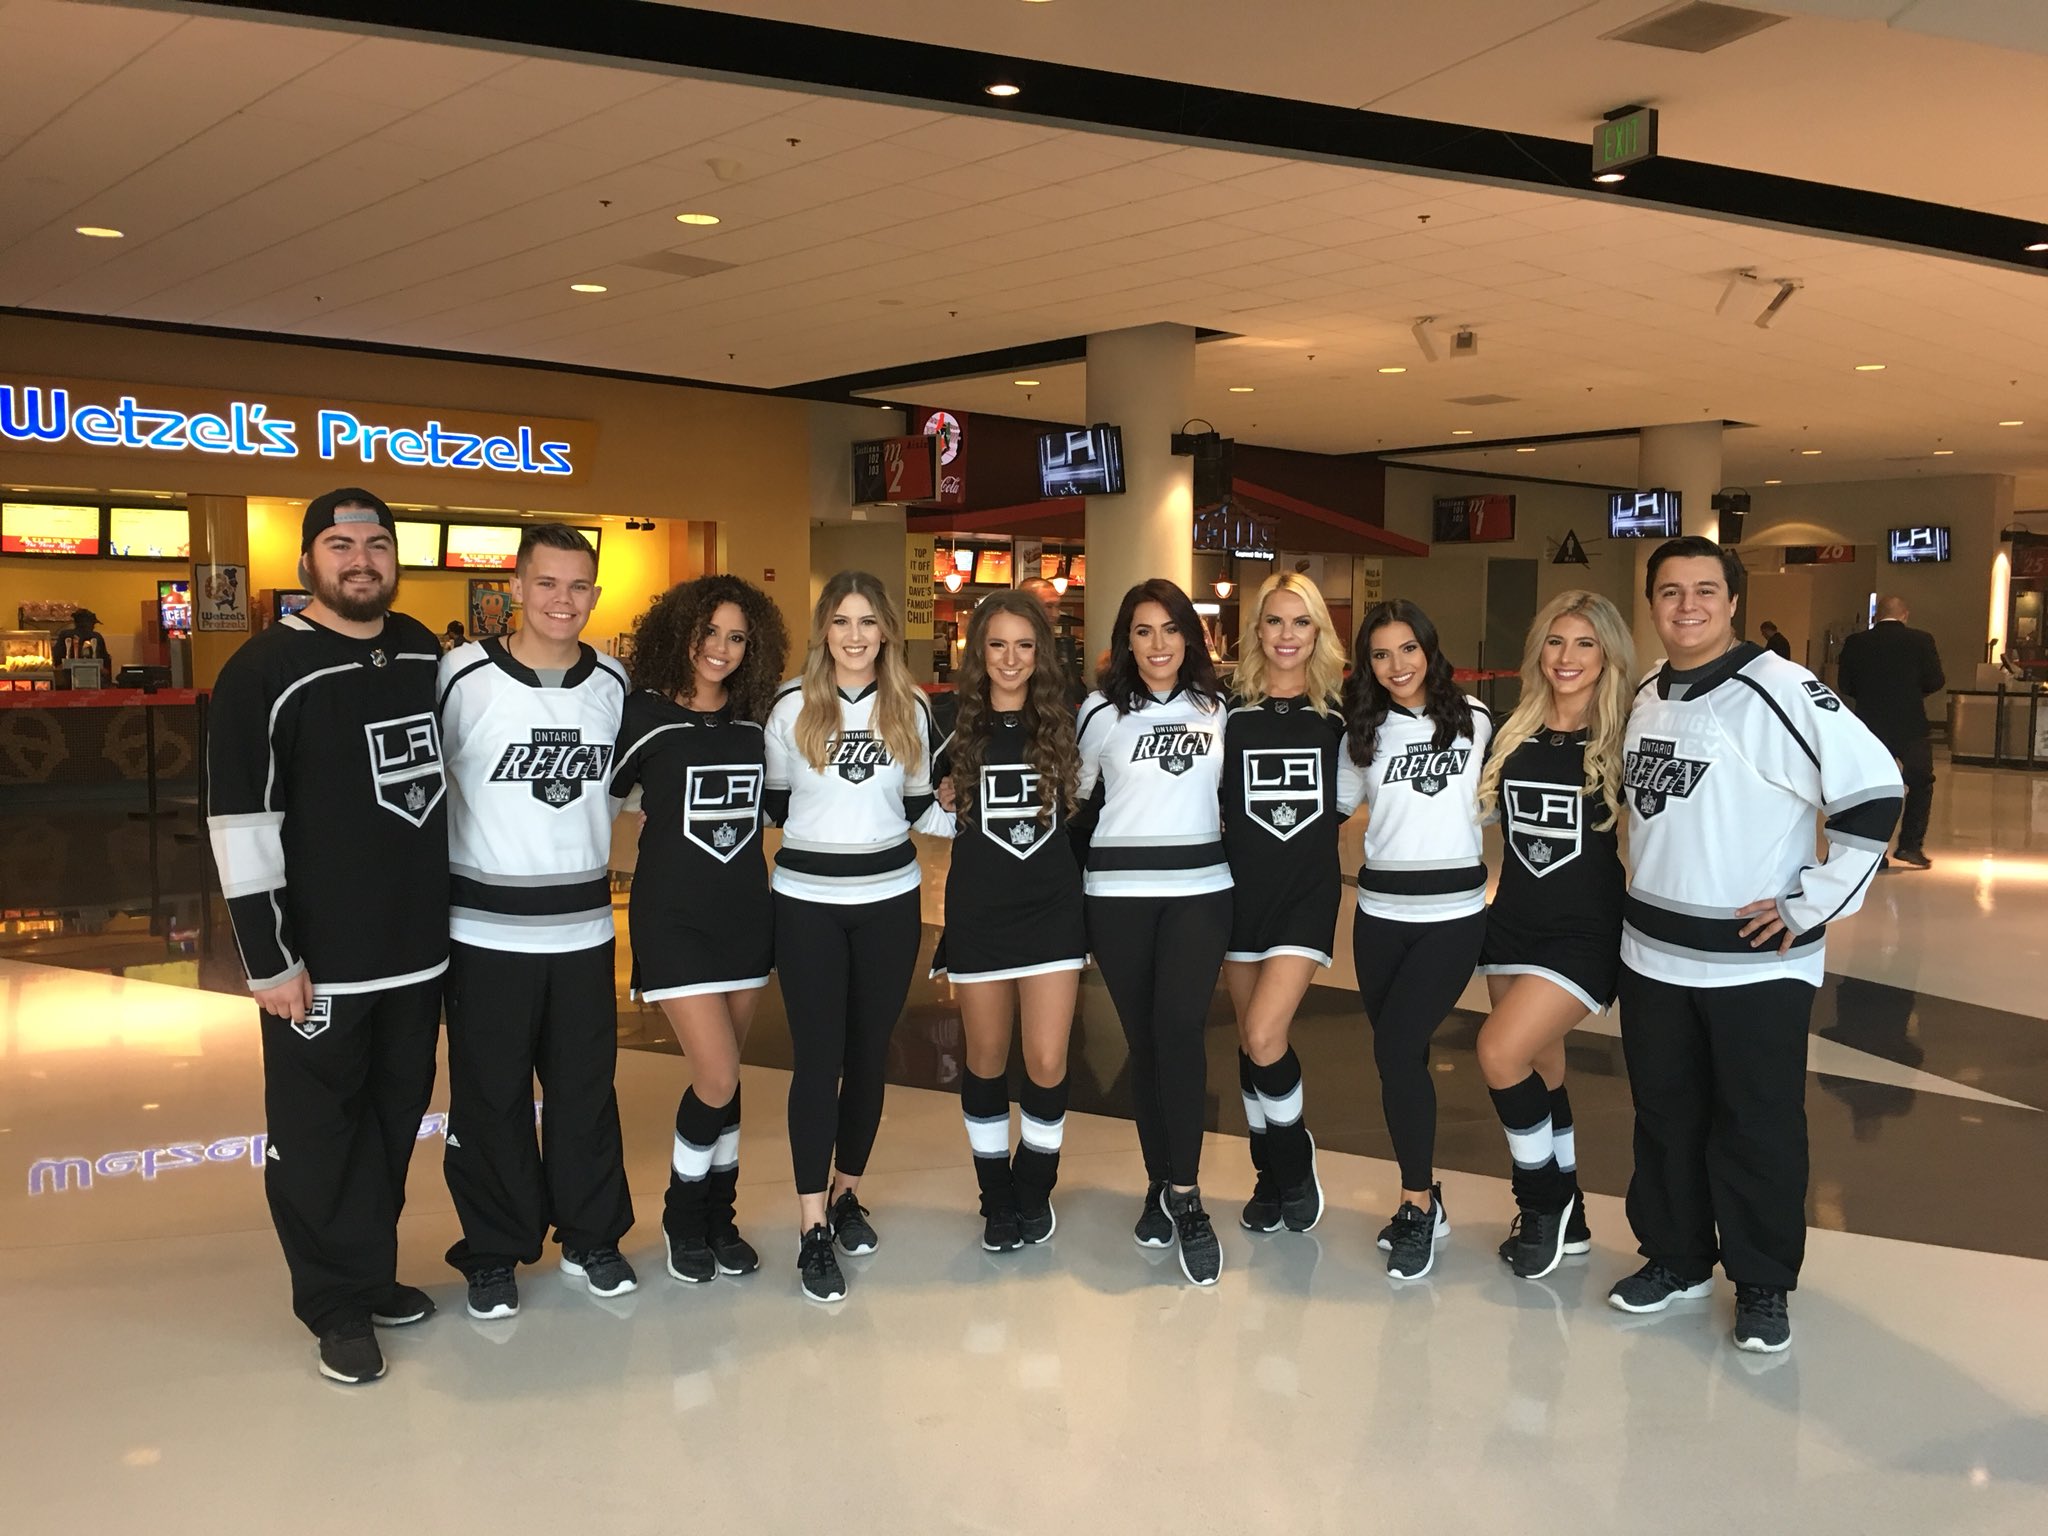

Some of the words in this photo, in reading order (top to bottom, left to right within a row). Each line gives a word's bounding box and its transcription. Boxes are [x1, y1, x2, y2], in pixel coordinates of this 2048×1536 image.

[1603, 118, 1639, 161] EXIT
[0, 385, 299, 457] Wetzel's
[318, 409, 572, 475] Pretzels
[868, 453, 879, 464] 102
[868, 465, 879, 476] 103
[888, 459, 904, 493] 2
[913, 548, 927, 558] TOP
[910, 561, 917, 570] IT
[918, 561, 931, 571] OFF
[911, 574, 929, 584] WITH
[908, 586, 932, 597] DAVE'S
[906, 598, 934, 610] FAMOUS
[165, 609, 186, 621] ICEE
[202, 612, 245, 621] Wetzel's
[907, 610, 933, 625] CHILI!
[202, 620, 246, 629] Pretzels
[1155, 725, 1186, 734] ONTARIO
[534, 731, 578, 743] ONTARIO
[374, 724, 437, 768] LA
[1135, 732, 1212, 760] REIGN
[1408, 743, 1436, 754] ONTAR
[1641, 740, 1672, 755] ONTARIO
[496, 745, 613, 780] REIGN
[1388, 750, 1469, 783] REIGN
[1249, 758, 1316, 787] LA
[1625, 753, 1707, 796] REIGN
[692, 775, 758, 806] LA
[1510, 790, 1576, 825] LA
